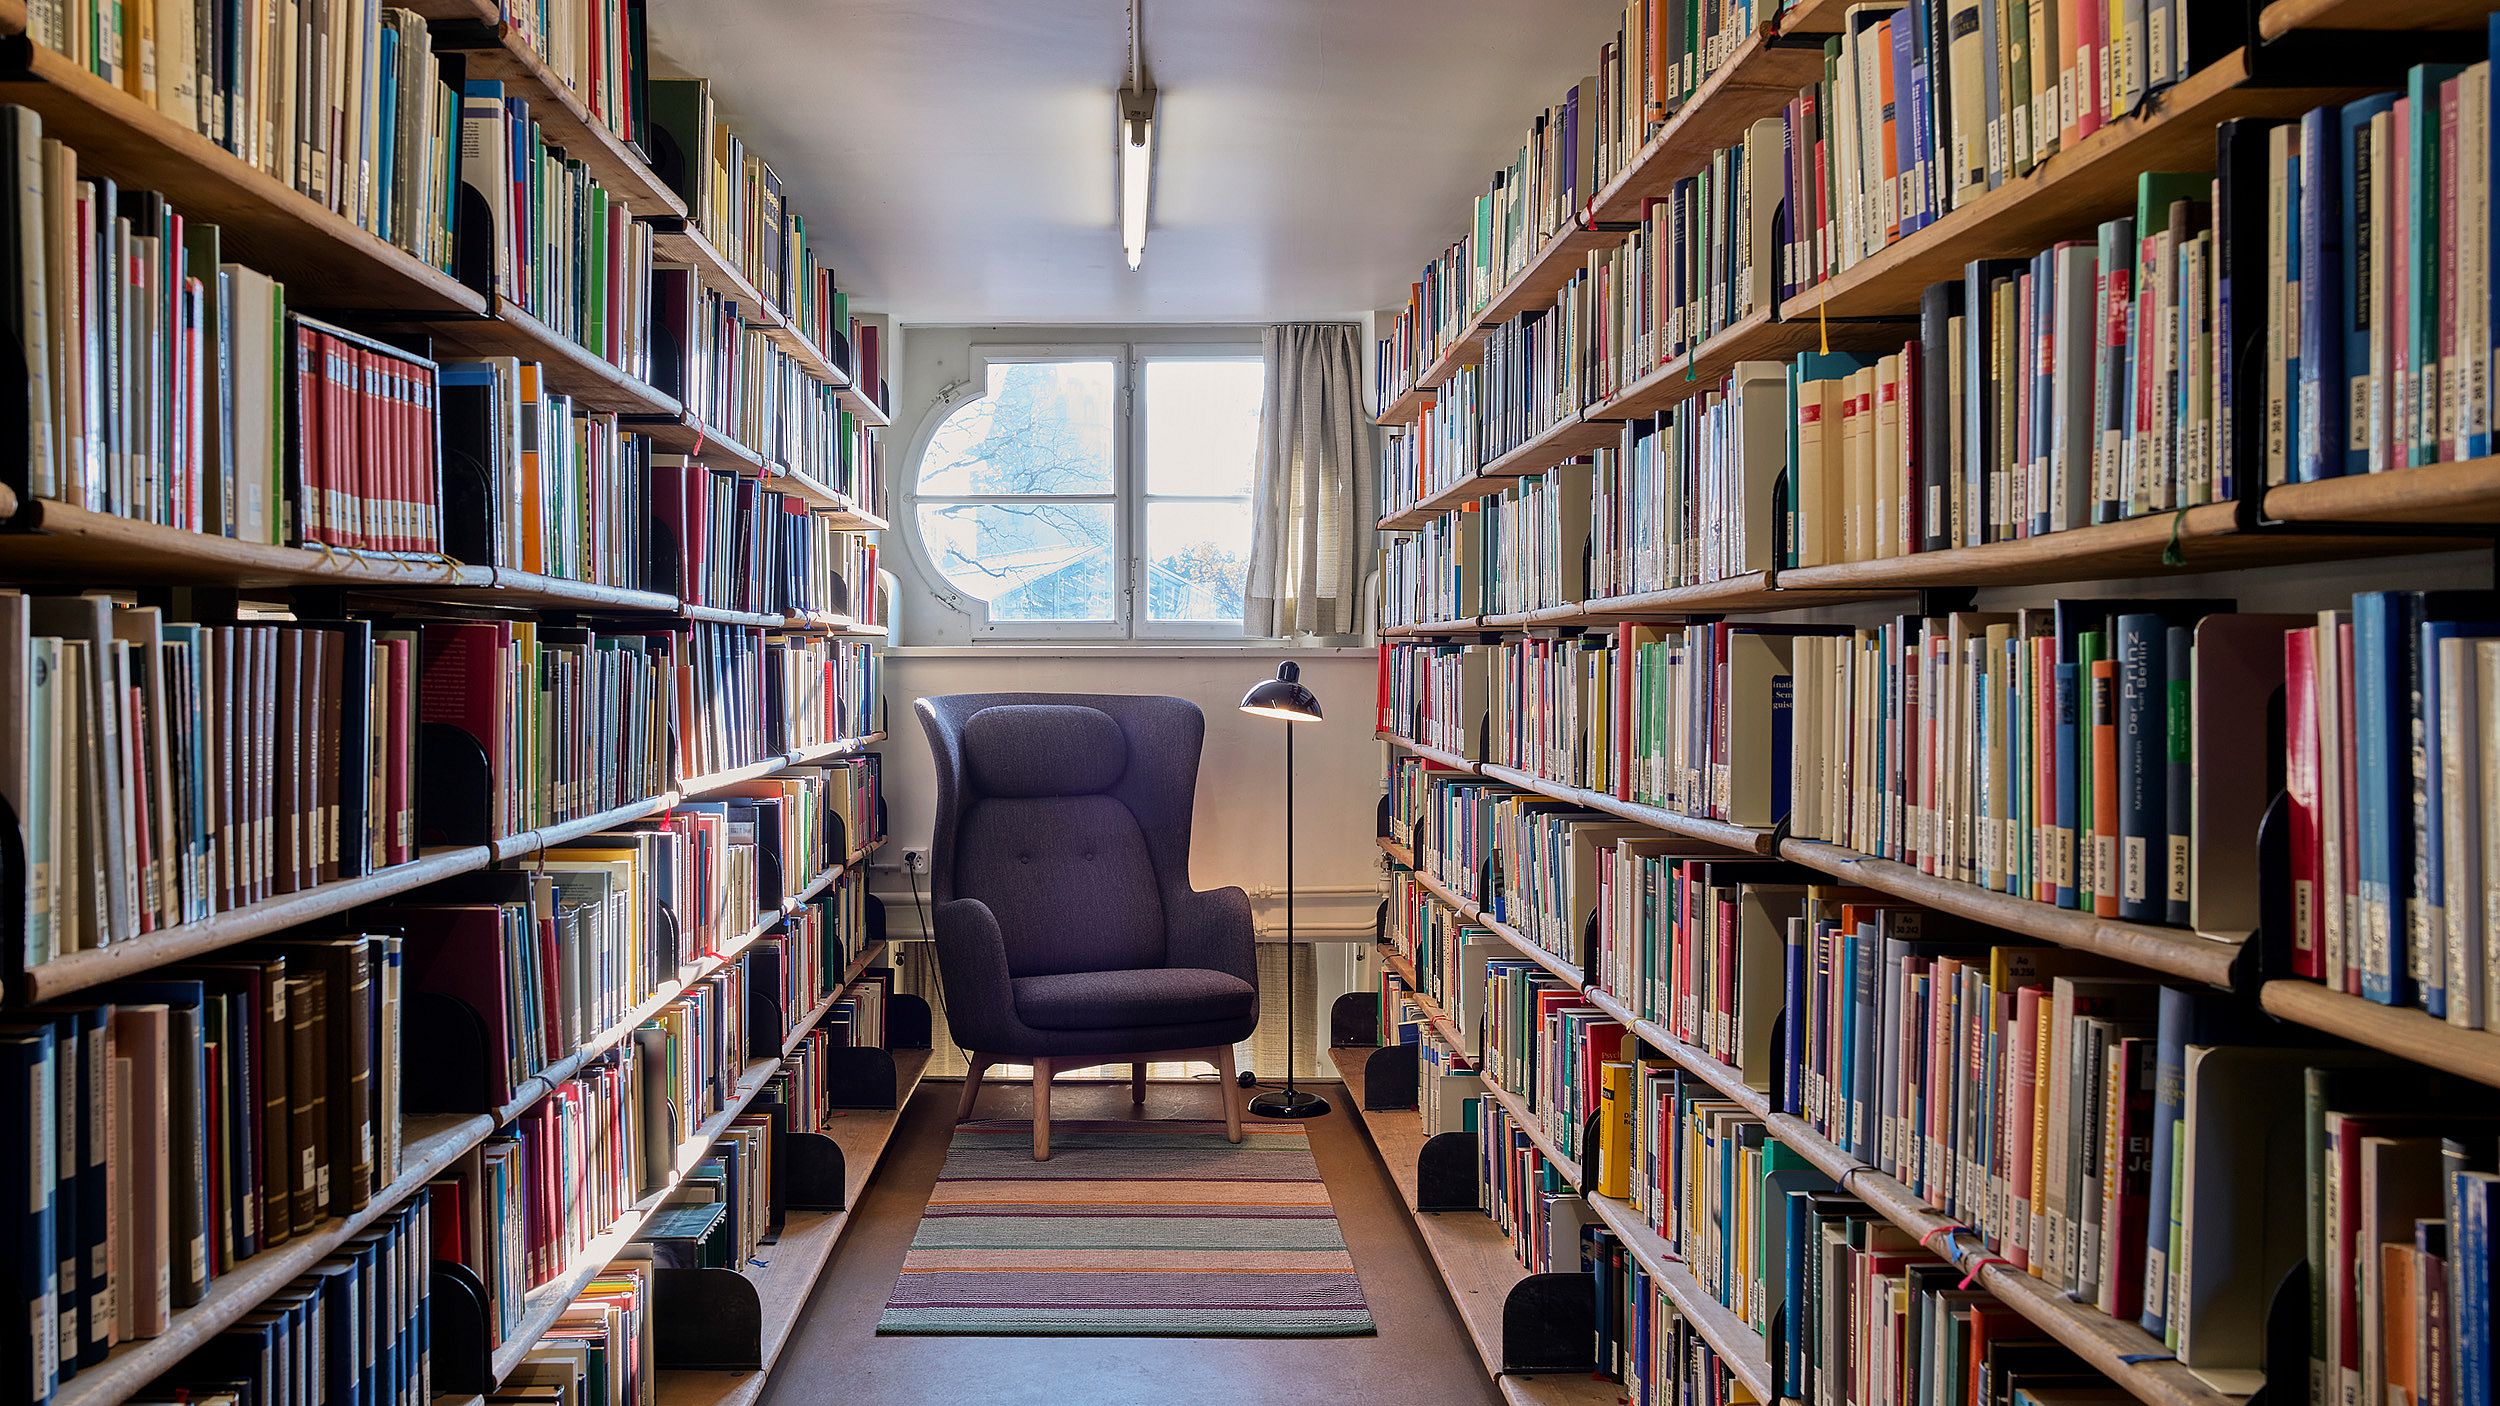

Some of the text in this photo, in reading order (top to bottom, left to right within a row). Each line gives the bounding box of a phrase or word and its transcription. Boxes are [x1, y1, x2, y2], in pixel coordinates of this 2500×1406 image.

[2124, 630, 2140, 735] Der Prinz
[2138, 640, 2148, 688] Berlin
